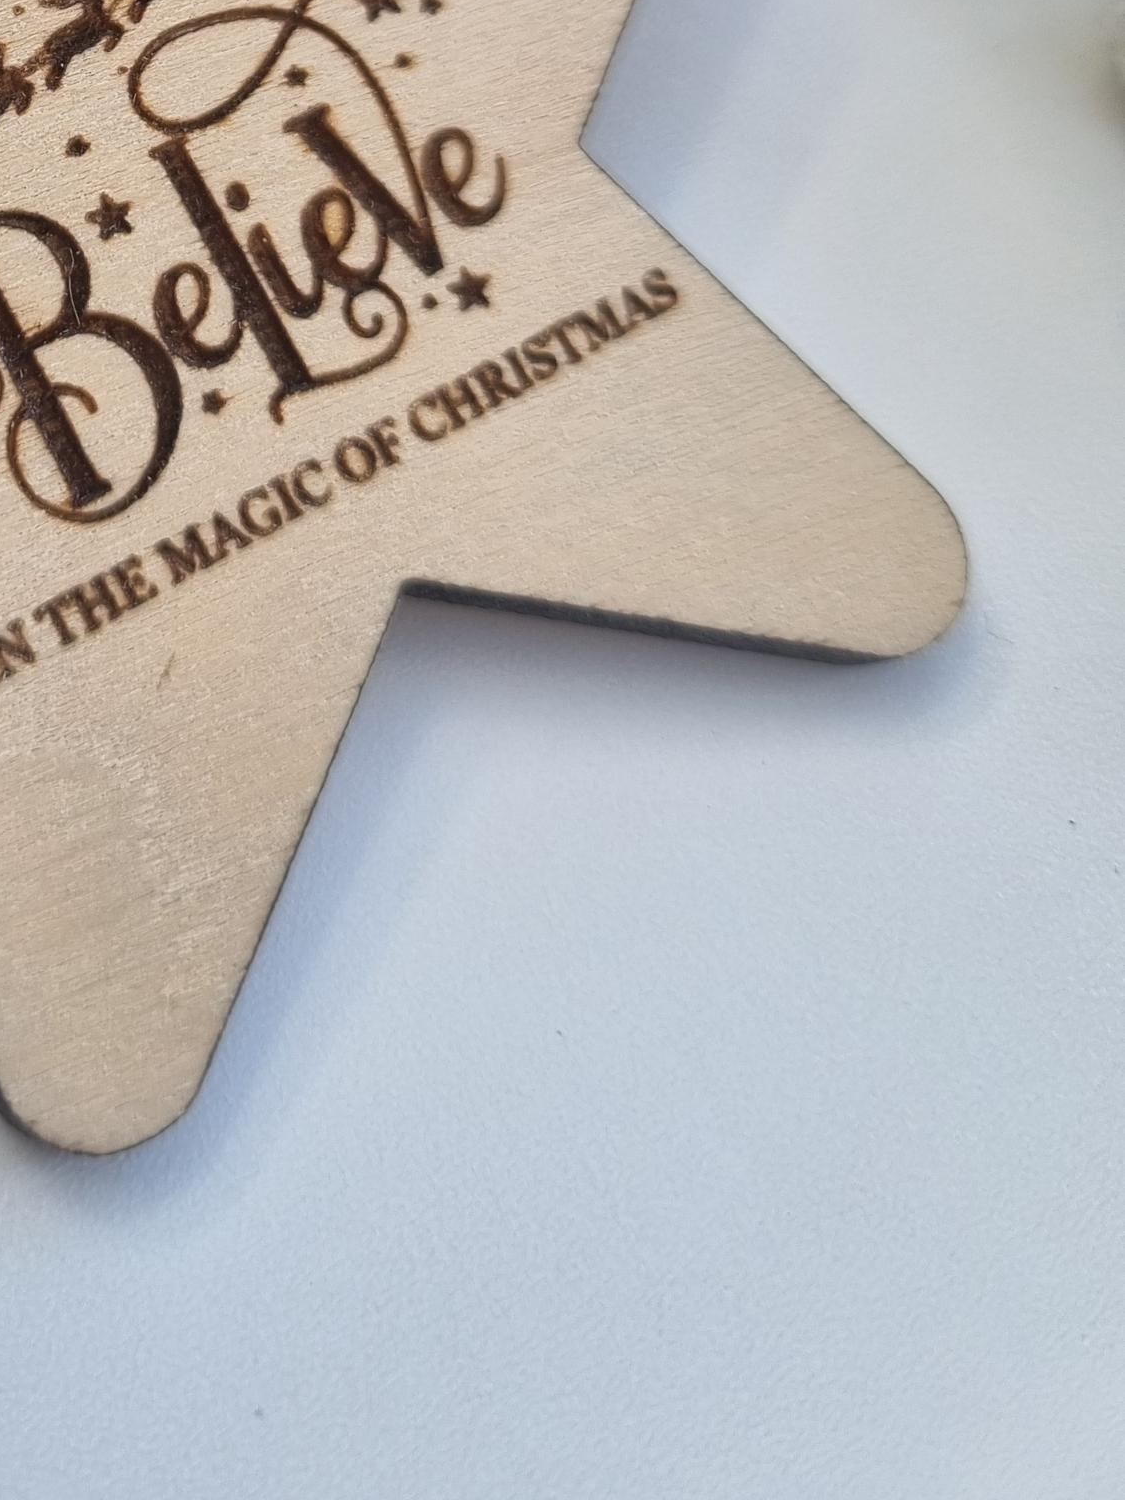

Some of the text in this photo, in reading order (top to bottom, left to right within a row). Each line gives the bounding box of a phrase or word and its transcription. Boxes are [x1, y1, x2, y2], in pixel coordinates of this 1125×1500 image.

[32, 553, 160, 655] THE
[159, 456, 333, 589] MAGIC
[334, 416, 399, 484] OF
[407, 267, 682, 444] CHRISTMAS
